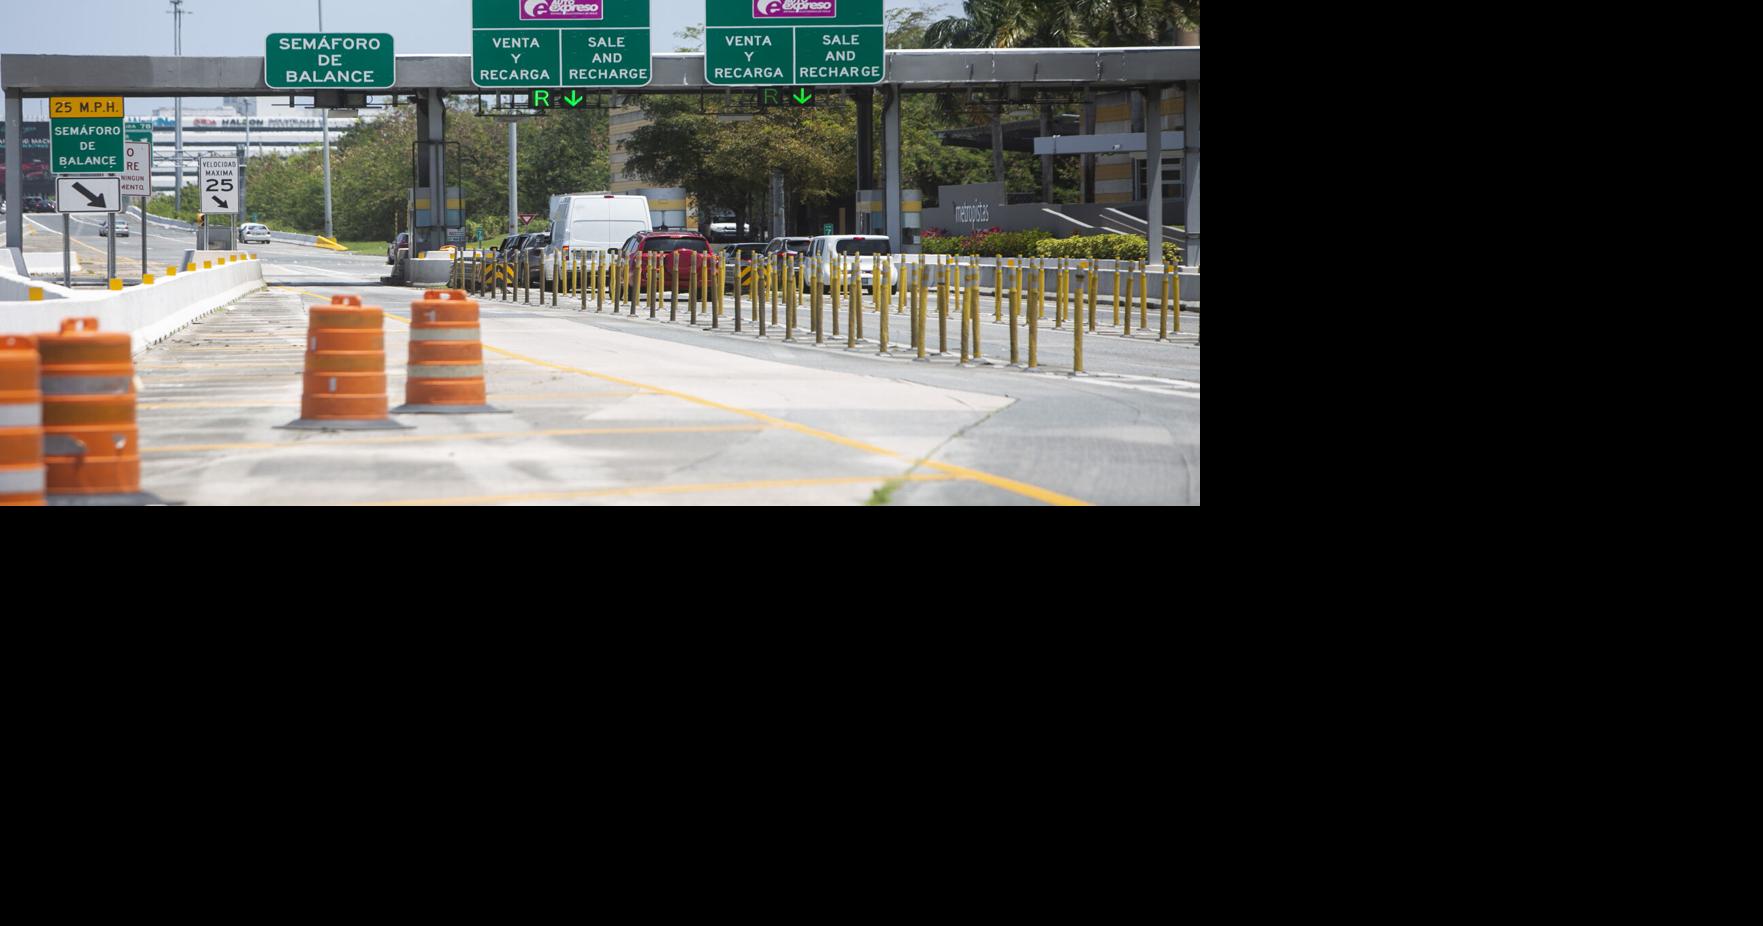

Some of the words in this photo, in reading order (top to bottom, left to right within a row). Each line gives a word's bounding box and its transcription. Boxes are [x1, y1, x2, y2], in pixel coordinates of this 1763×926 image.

[279, 35, 381, 50] SEMÁFORO
[492, 37, 540, 48] VENTA
[588, 37, 625, 48] SALE
[725, 35, 772, 46] VENTA
[822, 34, 860, 46] SALE
[318, 54, 342, 67] DE
[511, 53, 521, 64] Y
[592, 53, 622, 64] AND
[744, 51, 754, 62] Y
[825, 50, 856, 61] AND
[286, 70, 374, 83] BALANCE
[480, 69, 550, 80] RECARGA
[569, 69, 648, 80] RECHARGE
[714, 67, 784, 78] RECARGA
[800, 66, 880, 77] RECHARGE
[534, 89, 550, 107] R
[764, 88, 778, 104] R
[55, 102, 73, 113] 25
[79, 102, 119, 113] M.P.H.
[54, 124, 121, 136] SEMÁFORO
[79, 141, 96, 151] DE
[59, 156, 117, 166] BALANCE
[205, 178, 234, 192] 25
